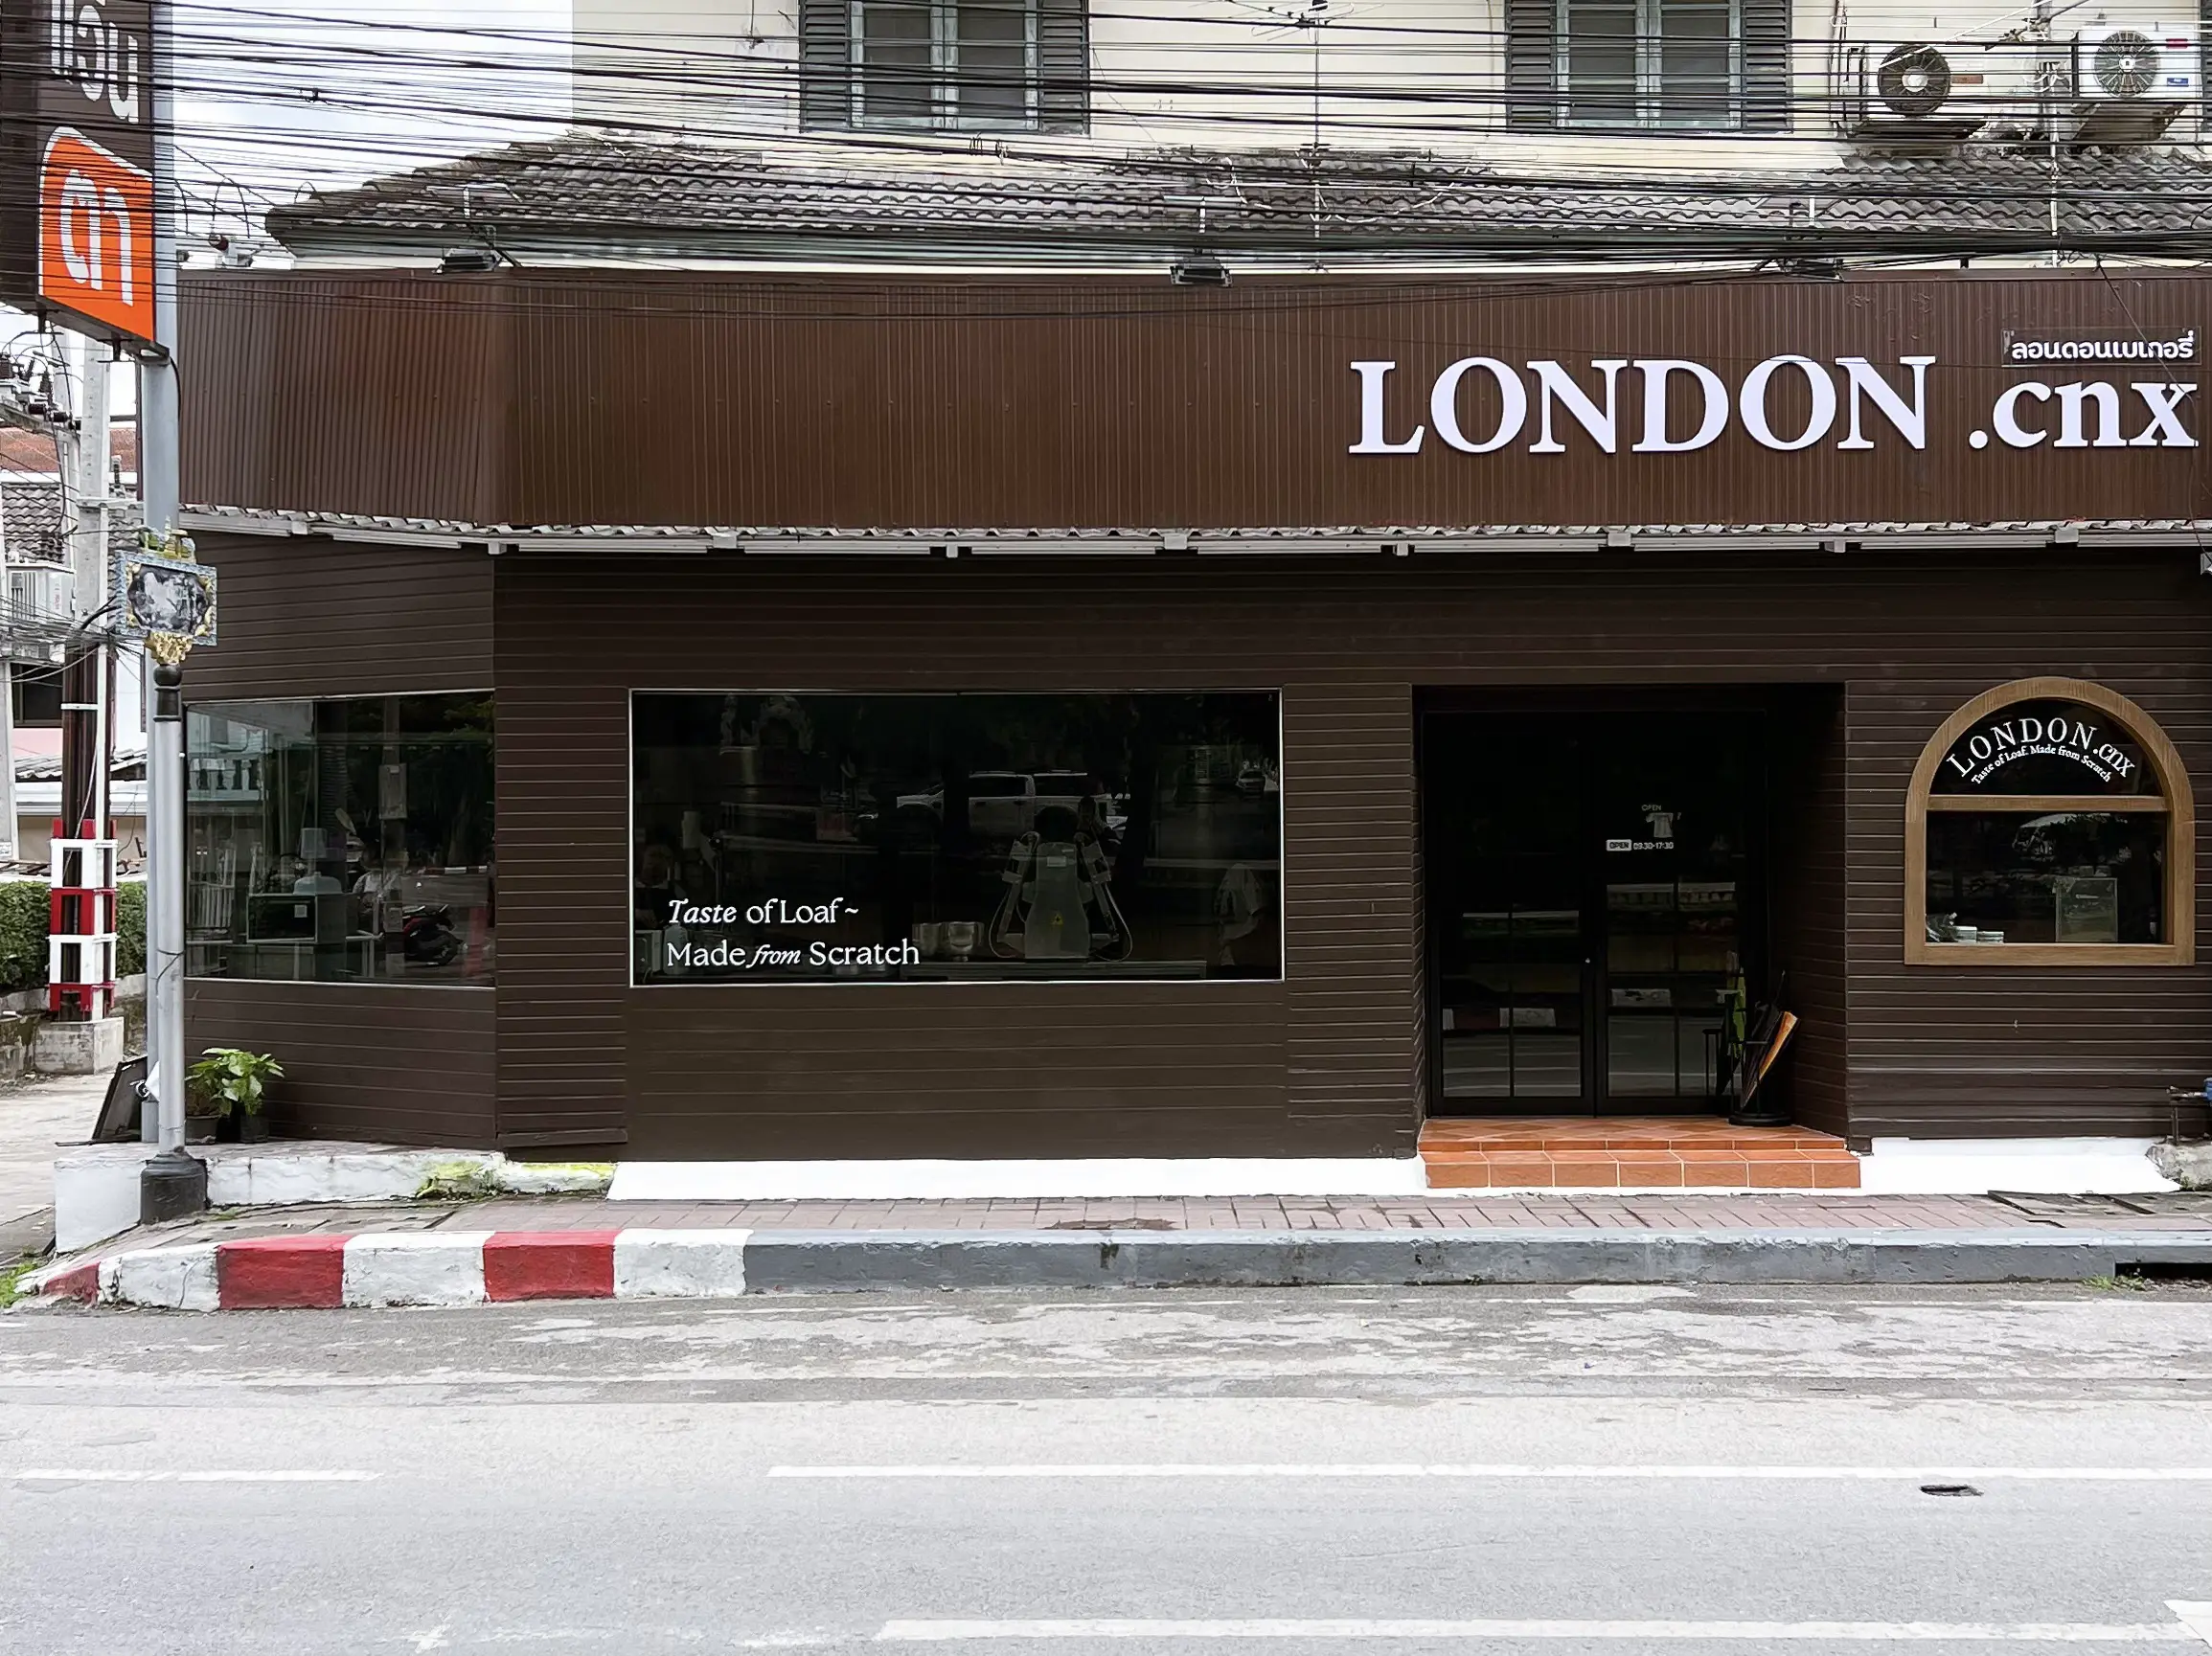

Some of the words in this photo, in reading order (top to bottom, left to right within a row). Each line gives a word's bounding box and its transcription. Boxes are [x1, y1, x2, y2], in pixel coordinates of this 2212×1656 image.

[2012, 329, 2195, 359] ลอนดอนเบเกอรี่
[1349, 354, 1936, 455] LONDON
[1969, 380, 2199, 449] .cnx
[1971, 762, 1995, 784] Taste
[1995, 753, 2006, 767] of
[2029, 743, 2057, 755] Made
[2058, 745, 2081, 761] from
[2081, 755, 2112, 783] Scratch
[668, 897, 738, 924] Taste
[745, 897, 779, 924] of
[667, 939, 746, 966] Made
[745, 943, 802, 969] from
[809, 938, 920, 966] Scratch
